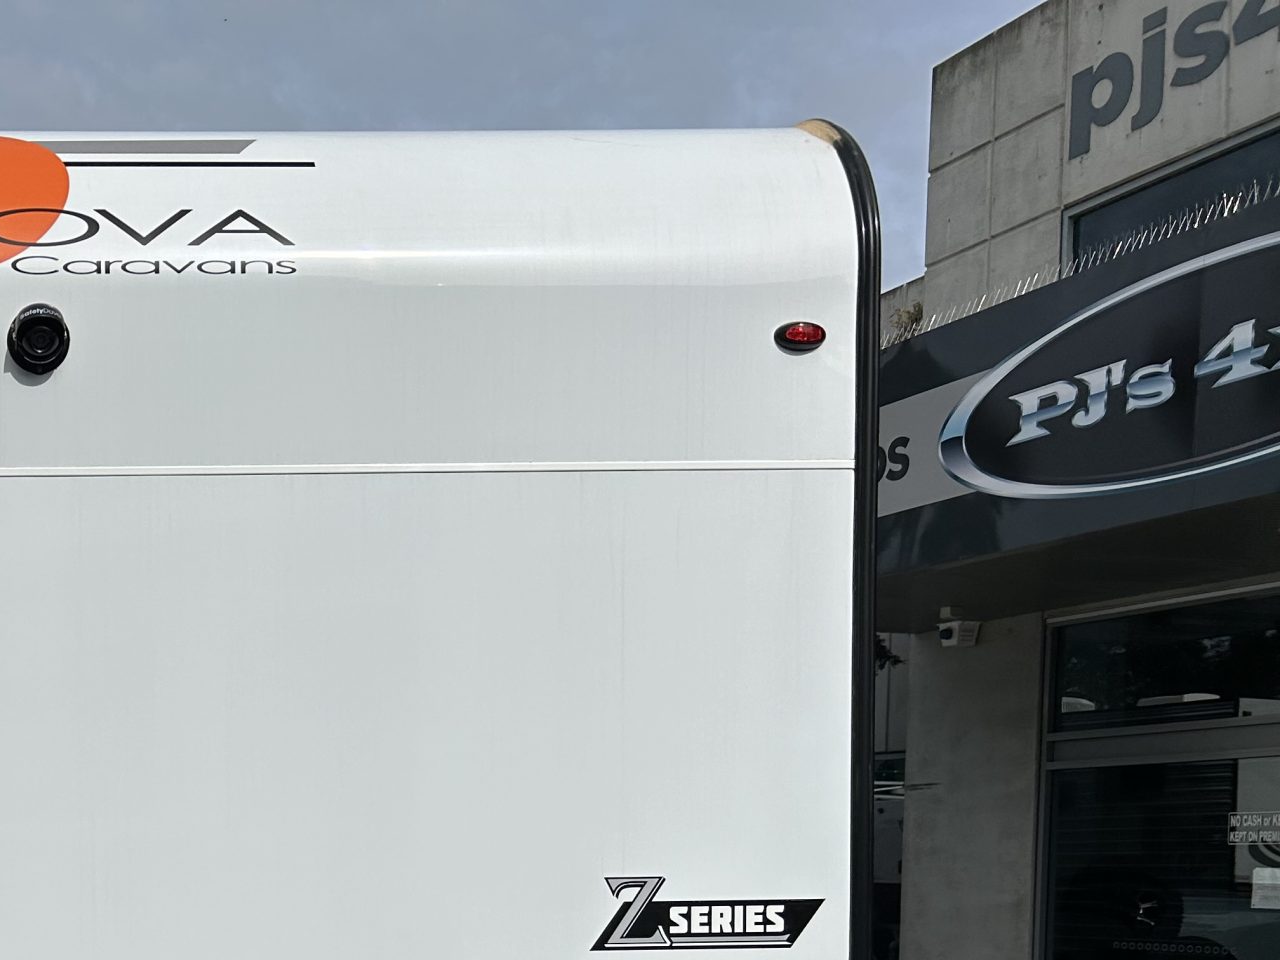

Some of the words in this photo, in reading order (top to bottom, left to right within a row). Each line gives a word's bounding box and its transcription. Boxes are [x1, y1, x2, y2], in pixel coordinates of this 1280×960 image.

[11, 255, 297, 276] Caravans
[1006, 358, 1176, 447] PJ's
[1230, 815, 1241, 827] NO
[1243, 814, 1262, 827] CASH
[1263, 816, 1271, 826] or
[1230, 831, 1247, 842] KEPT
[1248, 831, 1258, 842] ON
[604, 876, 673, 948] Z
[669, 904, 785, 934] SERIES
